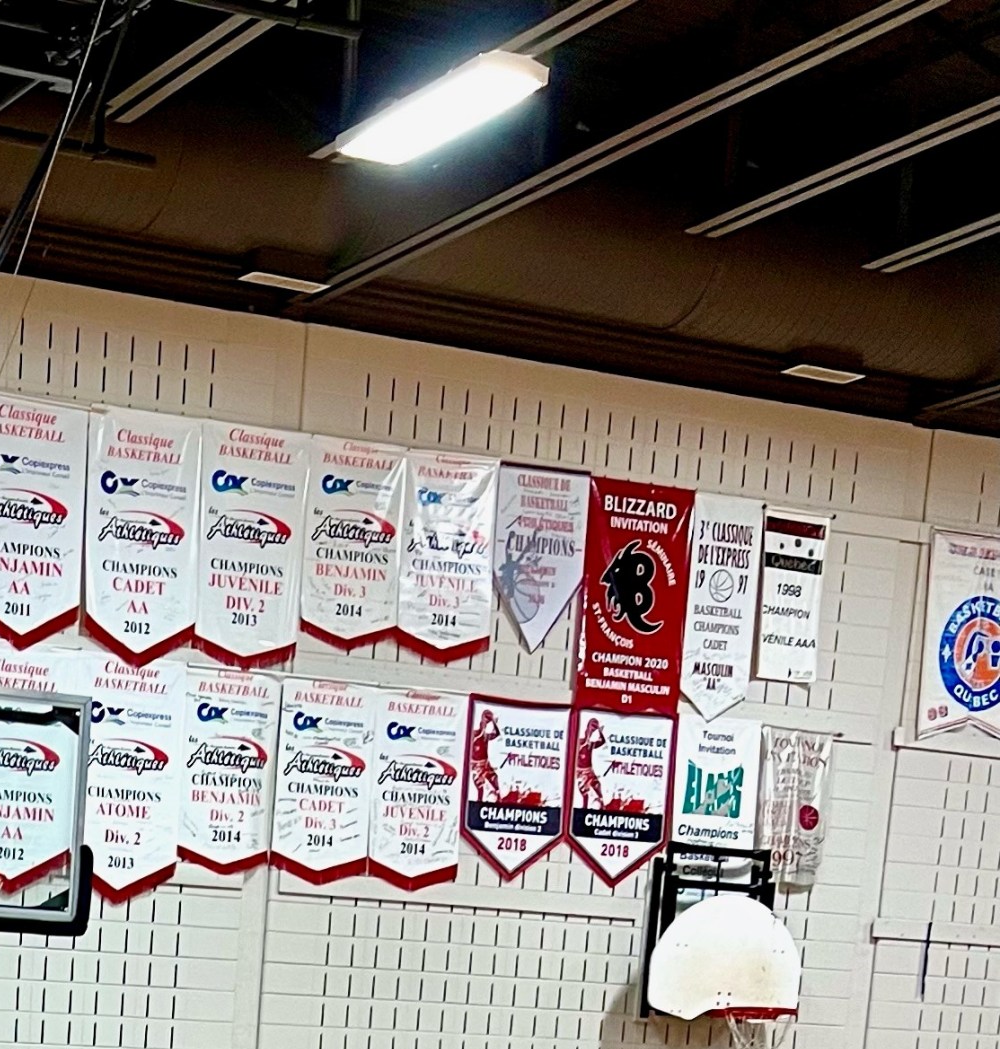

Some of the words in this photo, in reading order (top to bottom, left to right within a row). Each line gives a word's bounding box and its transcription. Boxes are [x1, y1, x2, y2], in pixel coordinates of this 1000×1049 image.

[117, 429, 174, 448] Classique
[229, 428, 285, 449] Classique
[107, 446, 182, 465] BASKETBALL
[219, 444, 292, 465] BASKETBALL
[323, 454, 394, 471] BASKETBALL
[518, 474, 560, 491] CLASSIQUE
[561, 479, 571, 491] DE
[605, 495, 677, 520] BLIZZARD
[611, 516, 668, 534] INVITATION
[712, 522, 753, 546] CLASSIQUE
[316, 547, 388, 564] CHAMPIONS
[698, 545, 707, 564] DE
[102, 559, 178, 579] CHAMPIONS
[211, 558, 283, 578] CHAMPIONS
[316, 563, 386, 581] BENJAMIN
[412, 558, 481, 575] CHAMPIONS
[9, 580, 30, 594] AA
[113, 576, 166, 595] CADET
[209, 571, 283, 595] JUVÉNILE
[334, 584, 359, 597] Div.
[360, 586, 366, 597] 3
[777, 583, 801, 597] 1998
[4, 602, 30, 616] 2011
[127, 601, 149, 614] AA
[226, 595, 253, 612] DIV.
[258, 601, 265, 613] 2
[336, 603, 362, 617] 2014
[694, 605, 742, 619] BASKETBALL
[232, 613, 257, 627] 2013
[431, 613, 457, 627] 2014
[124, 621, 150, 635] 2012
[694, 621, 739, 635] CHAMPIONS
[703, 639, 728, 650] CADET
[592, 652, 643, 667] CHAMPION
[645, 657, 668, 669] 2020
[105, 661, 160, 679] Classique
[603, 667, 653, 681] BASKETBALL
[693, 662, 733, 677] MASCULIN
[95, 677, 168, 695] BASKETBALL
[199, 682, 269, 699] BASKETBALL
[586, 679, 626, 691] BENJAMIN
[628, 682, 670, 695] MASCULIN
[295, 691, 364, 708] BASKETBALL
[621, 694, 632, 704] D1
[388, 702, 457, 717] BASKETBALL
[504, 726, 551, 738] CLASSIQUE
[553, 730, 563, 739] DE
[703, 730, 734, 742] Tournoi
[505, 738, 560, 751] BASKETBALL
[609, 734, 654, 747] CLASSIQUE
[657, 738, 667, 748] DE
[611, 746, 663, 759] BASKETBALL
[699, 744, 736, 755] Invitation
[500, 752, 560, 770] ATHLÉTIQUES
[604, 759, 663, 778] ATHLÉTIQUES
[88, 786, 161, 802] CHAMPIONS
[288, 782, 359, 798] CHAMPIONS
[382, 790, 450, 805] CHAMPIONS
[96, 803, 150, 819] ATOME
[299, 799, 345, 814] CADET
[210, 809, 234, 823] Div.
[238, 811, 244, 822] 2
[480, 807, 548, 824] CHAMPIONS
[585, 814, 650, 831] CHAMPIONS
[305, 817, 328, 830] Div.
[330, 819, 336, 829] 3
[399, 824, 422, 837] Div.
[424, 828, 429, 837] 2
[2, 826, 23, 840] AA
[105, 829, 130, 845] Div.
[134, 832, 140, 845] 2
[212, 830, 241, 843] 2014
[678, 824, 739, 840] Champions
[307, 835, 333, 847] 2014
[401, 842, 426, 855] 2014
[498, 837, 527, 851] 2018
[601, 844, 629, 857] 2018
[108, 856, 134, 869] 2013
